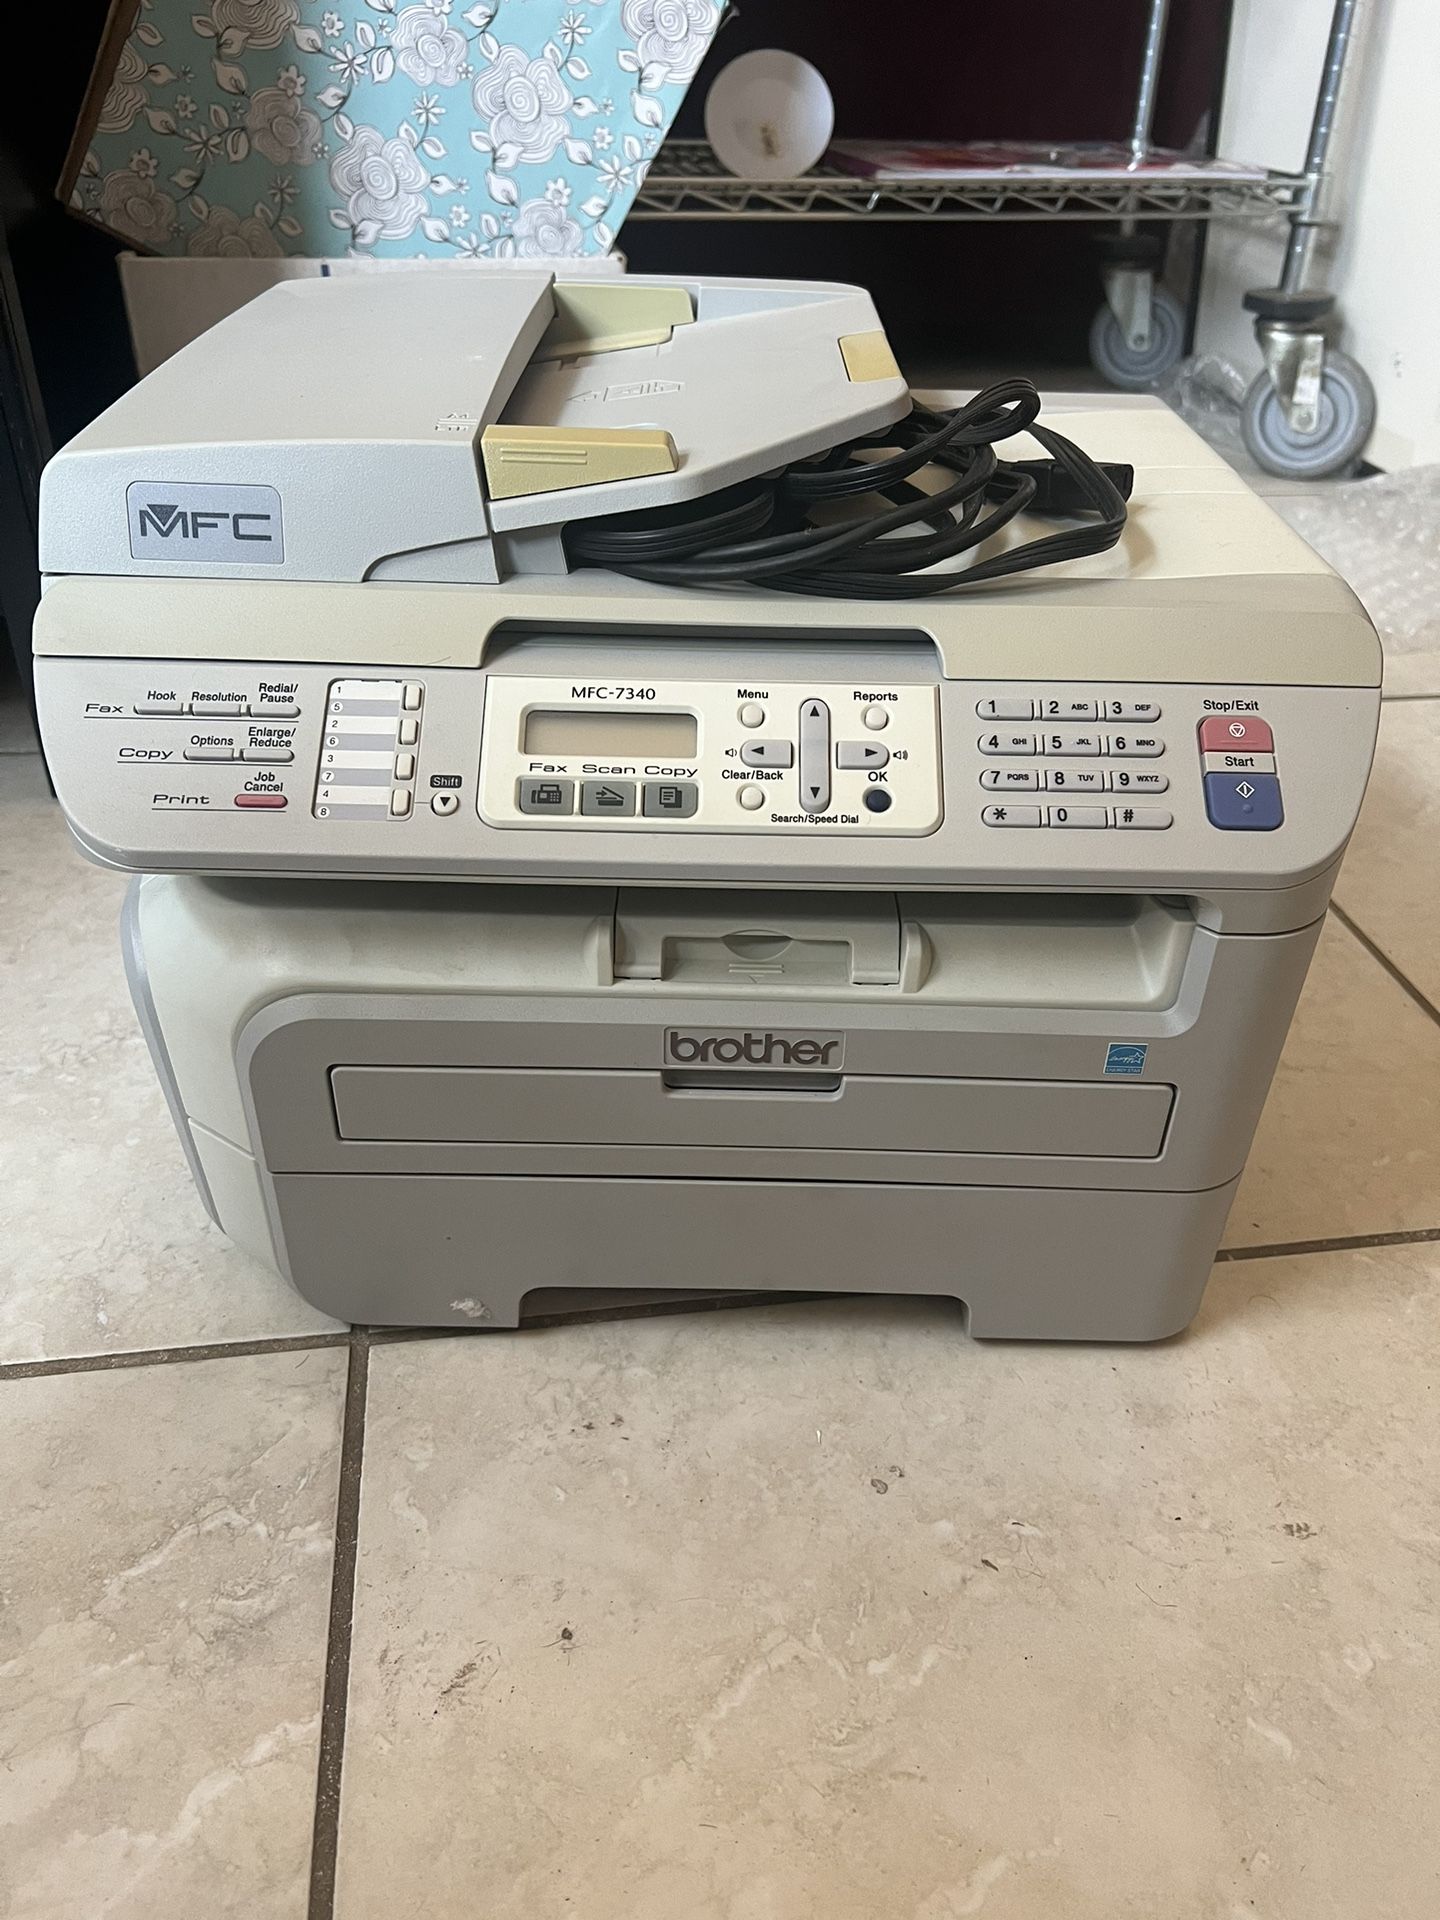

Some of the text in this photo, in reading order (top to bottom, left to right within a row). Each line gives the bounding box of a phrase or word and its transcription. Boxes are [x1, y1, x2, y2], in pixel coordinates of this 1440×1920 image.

[140, 503, 272, 541] MFC
[258, 682, 298, 694] Redial/
[336, 686, 342, 694] 1
[571, 686, 656, 701] MFC-7340
[737, 688, 769, 700] Menu
[147, 690, 177, 702] Hook
[191, 691, 248, 703] Resolution
[259, 693, 295, 704] Pause
[853, 690, 899, 704] Reports
[84, 703, 124, 714] Fax
[334, 703, 341, 711] 5
[988, 701, 996, 714] 1
[1049, 701, 1089, 715] 2 ABC
[1112, 701, 1123, 715] 3
[1203, 699, 1260, 713] Stop/Exit
[331, 720, 338, 728] 2
[248, 726, 296, 740] Enlarge/
[190, 734, 234, 748] Options
[249, 737, 292, 748] Reduce
[329, 737, 336, 746] 6
[987, 735, 1027, 748] 4 GHI
[1051, 735, 1092, 749] 5 JKL
[1115, 737, 1156, 750] 6 MNO
[118, 747, 174, 761] Copy
[327, 754, 334, 763] 3
[1224, 755, 1255, 768] Start
[325, 772, 332, 781] 7
[529, 762, 699, 778] Fax Scan Copy
[721, 768, 784, 782] Clear/Back
[868, 770, 889, 783] OK
[254, 771, 276, 783] Job
[433, 776, 459, 787] Shift
[991, 771, 1030, 785] 7 PQRS
[1054, 772, 1095, 785] 8 TUV
[1118, 772, 1160, 786] 9 WXYZ
[243, 780, 284, 793] Cancel
[153, 794, 211, 805] Print
[322, 789, 329, 798] 4
[320, 807, 328, 816] 8
[1057, 808, 1068, 822] 0
[1122, 809, 1134, 823] #
[770, 812, 860, 826] Search/Speed Dial
[671, 1031, 839, 1065] brother
